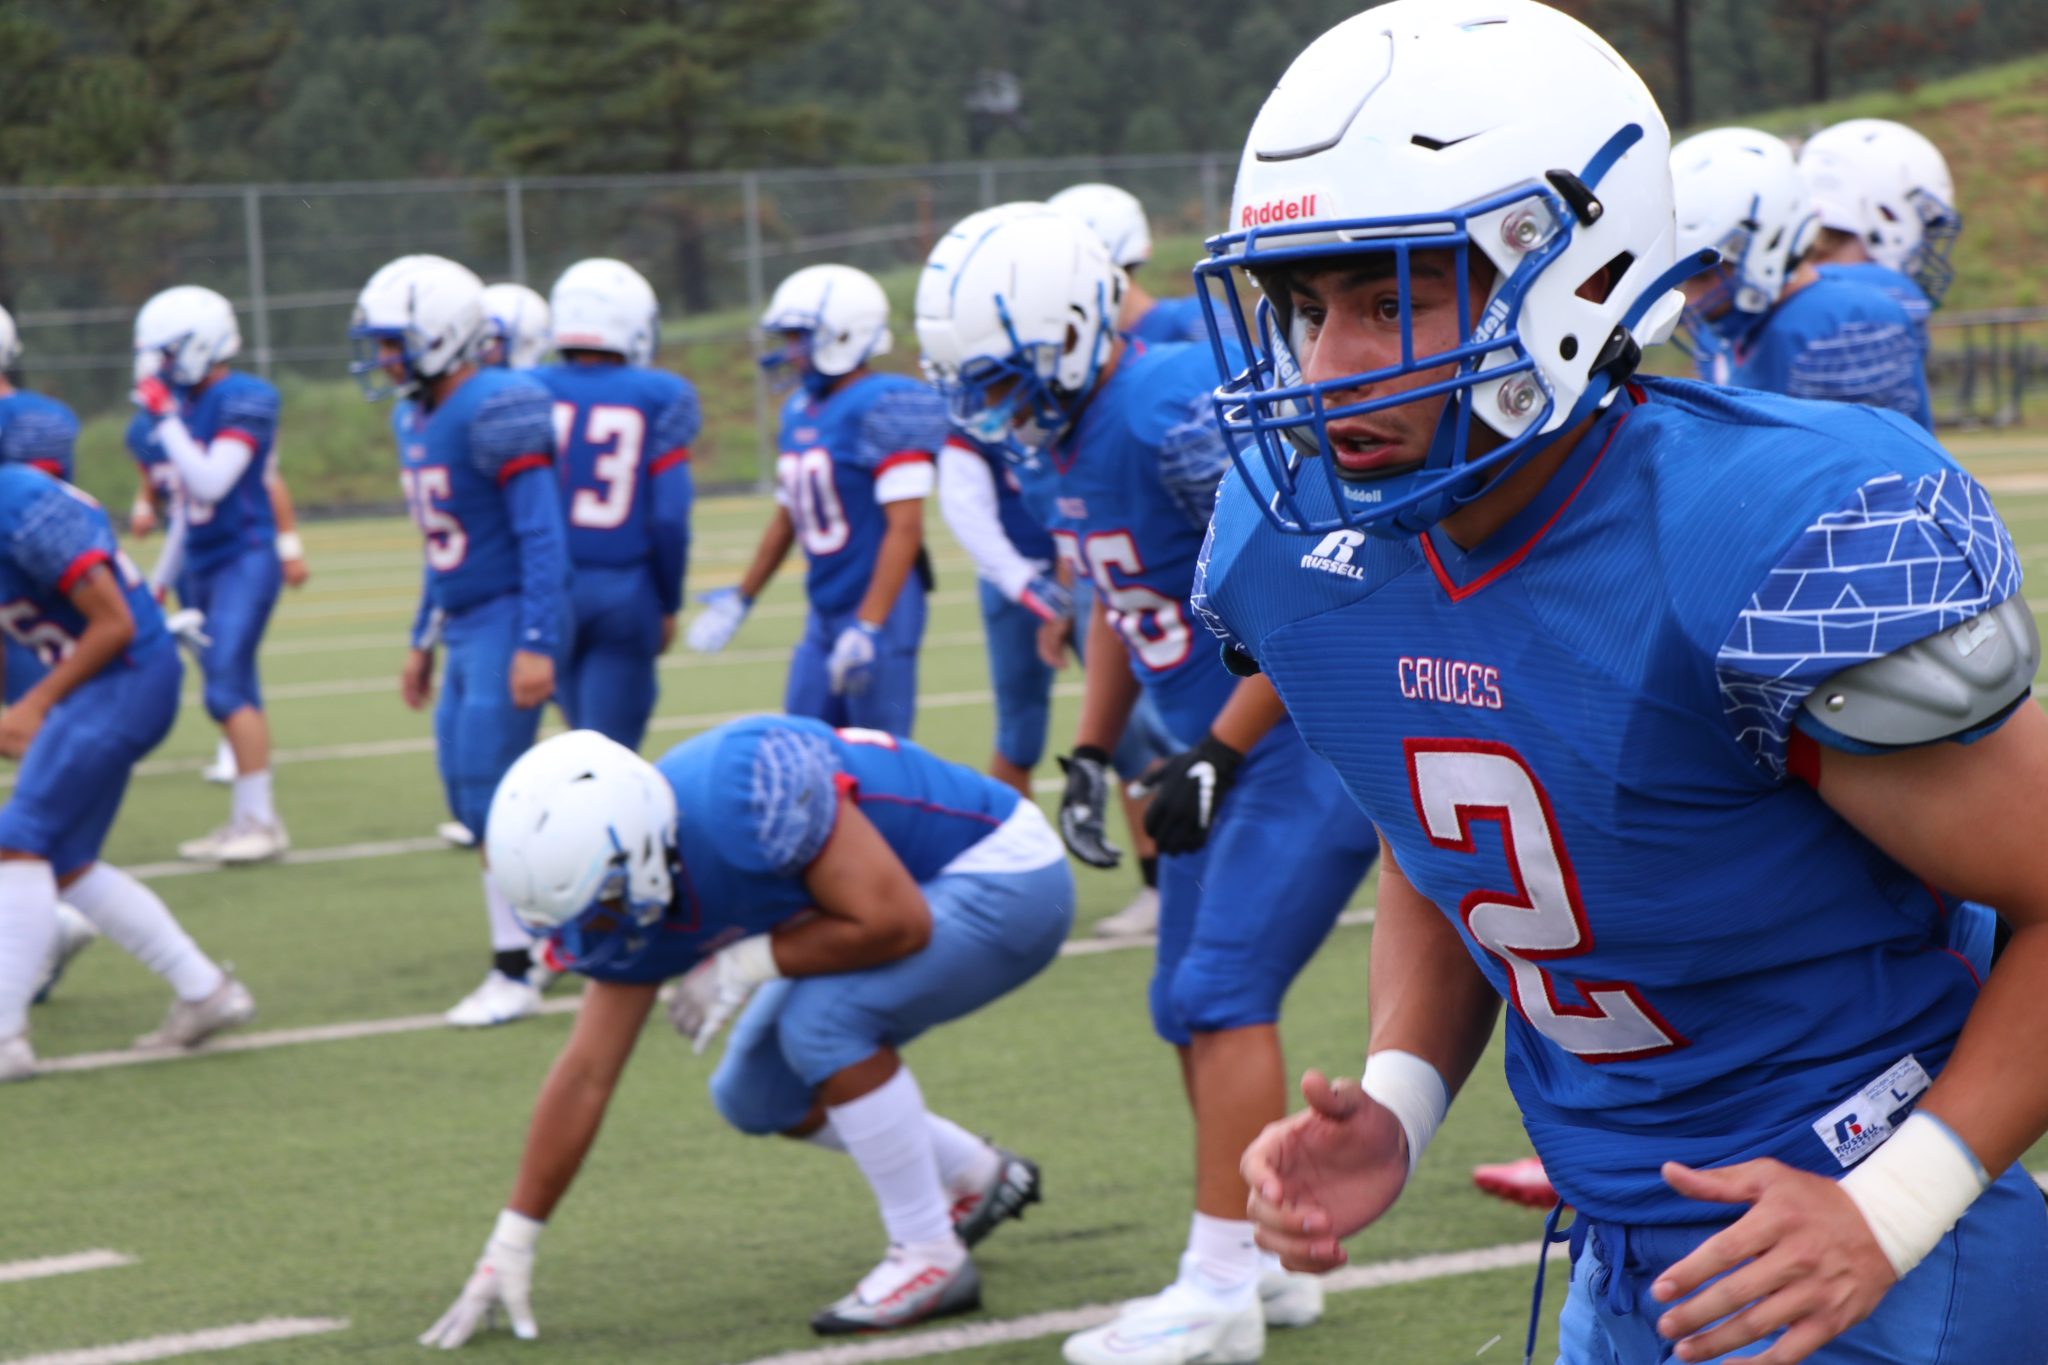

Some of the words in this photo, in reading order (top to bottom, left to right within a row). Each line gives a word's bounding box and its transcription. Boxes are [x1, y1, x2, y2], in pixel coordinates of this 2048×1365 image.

[1242, 194, 1316, 228] Riddell
[1300, 554, 1364, 580] RUSSELL
[1398, 656, 1503, 710] CRUCES
[1402, 737, 1692, 1064] 2
[1890, 1088, 1909, 1102] L
[1835, 1123, 1878, 1154] RUSSELL
